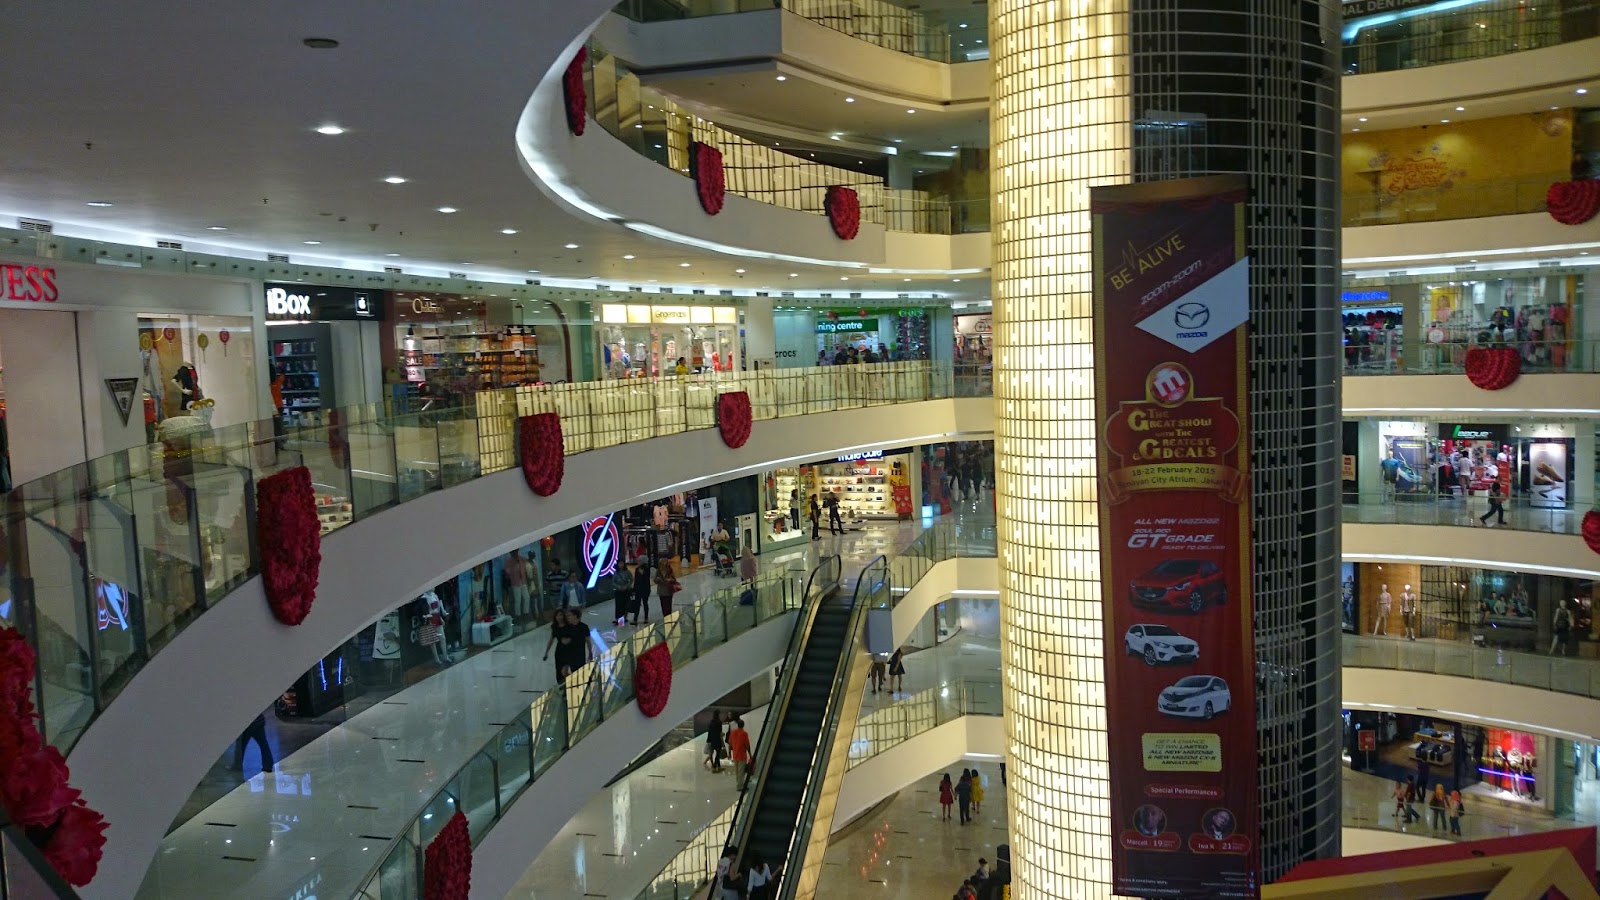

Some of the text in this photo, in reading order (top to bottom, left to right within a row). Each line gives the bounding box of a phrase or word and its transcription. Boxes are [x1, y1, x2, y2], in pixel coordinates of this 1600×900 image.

[1110, 234, 1187, 290] BE ALIVE
[266, 288, 311, 314] iBox
[837, 321, 863, 330] centre
[406, 357, 423, 366] SALE
[1157, 466, 1192, 475] February
[1195, 466, 1216, 475] 2015
[1151, 477, 1167, 485] City
[1127, 534, 1215, 549] GT GRADE
[1150, 786, 1218, 797] Special Performances
